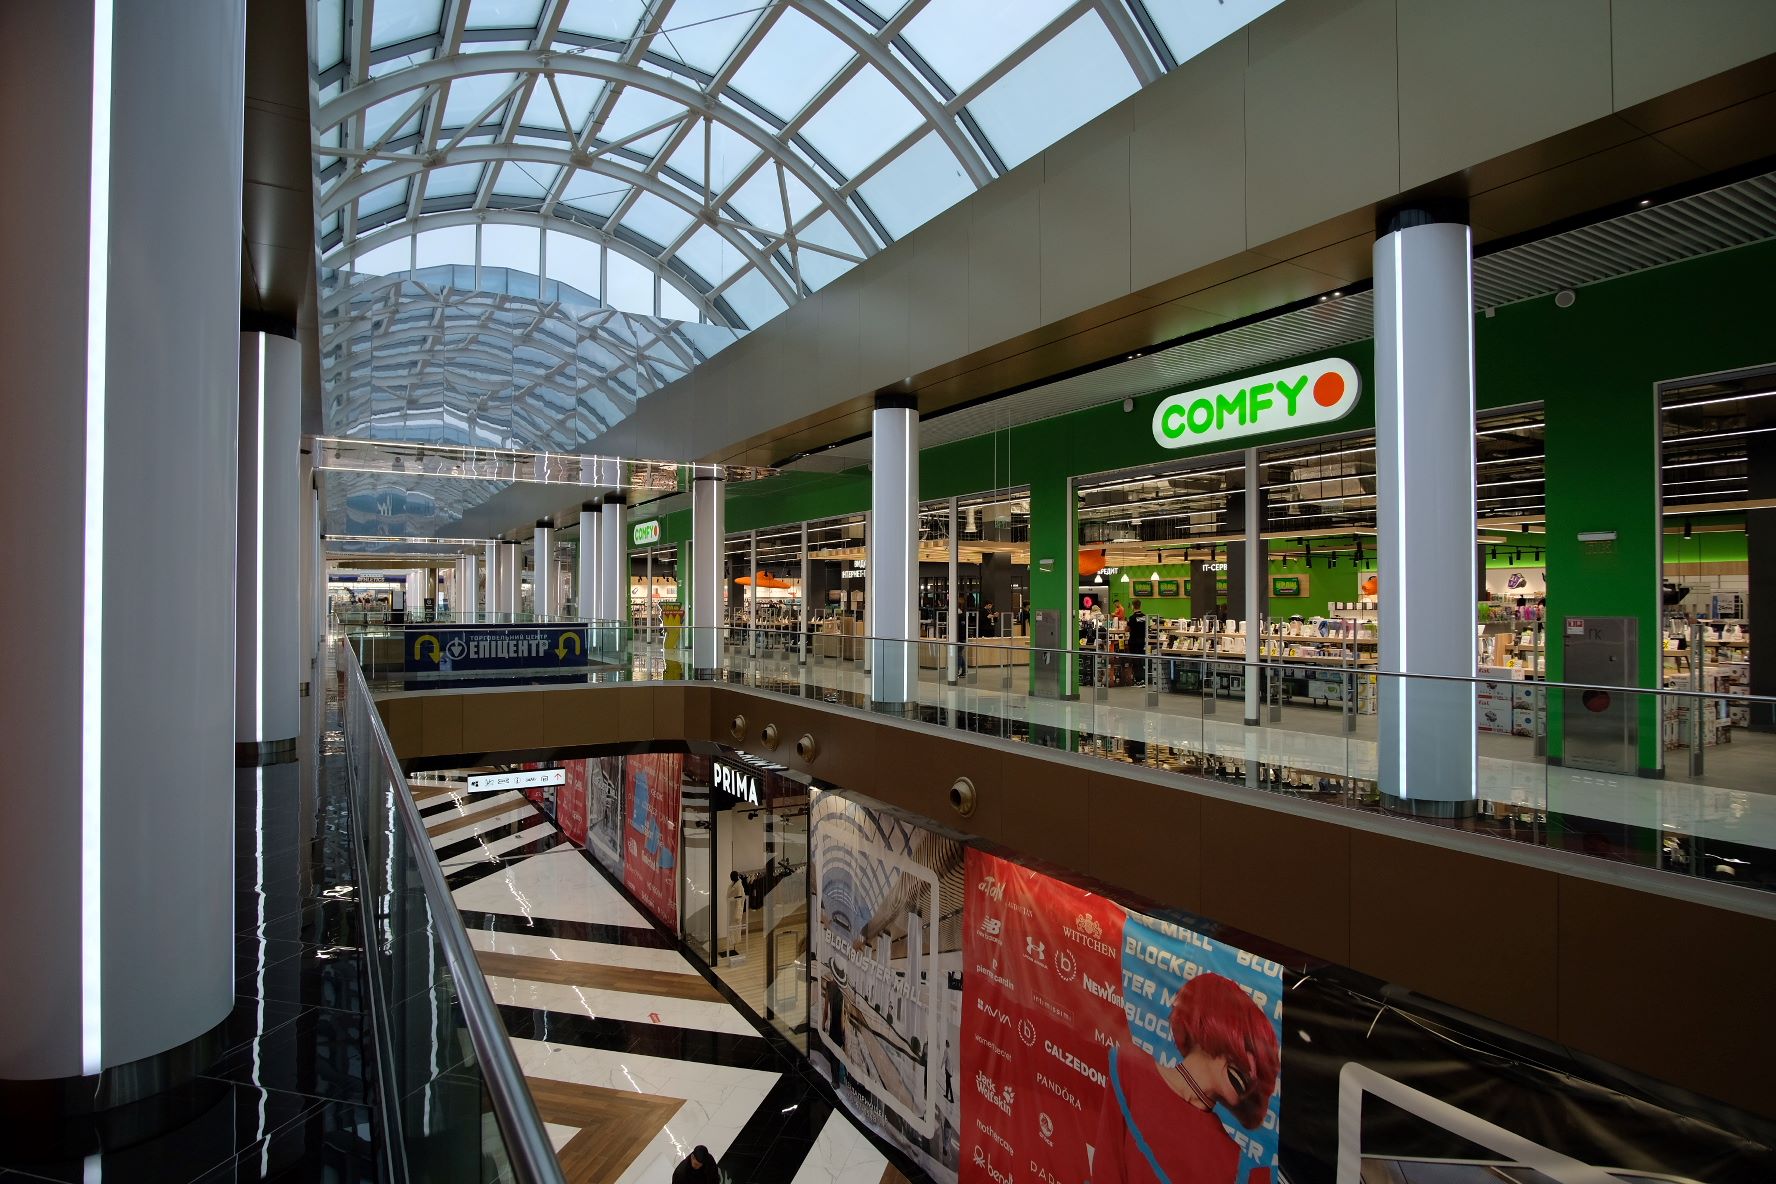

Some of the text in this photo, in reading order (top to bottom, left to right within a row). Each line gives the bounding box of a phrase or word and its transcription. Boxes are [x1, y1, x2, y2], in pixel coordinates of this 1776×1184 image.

[1161, 374, 1309, 439] COMFY
[635, 525, 654, 541] COMFY
[469, 640, 549, 659] ЕПІЦЕНТР
[713, 762, 758, 806] PRIMA
[824, 928, 892, 984] BLOCKBUSTER
[1062, 925, 1116, 959] WITTCHEN
[975, 1079, 1011, 1117] Wolfskin
[976, 1069, 997, 1093] Jack
[976, 1118, 1014, 1157] mothercare
